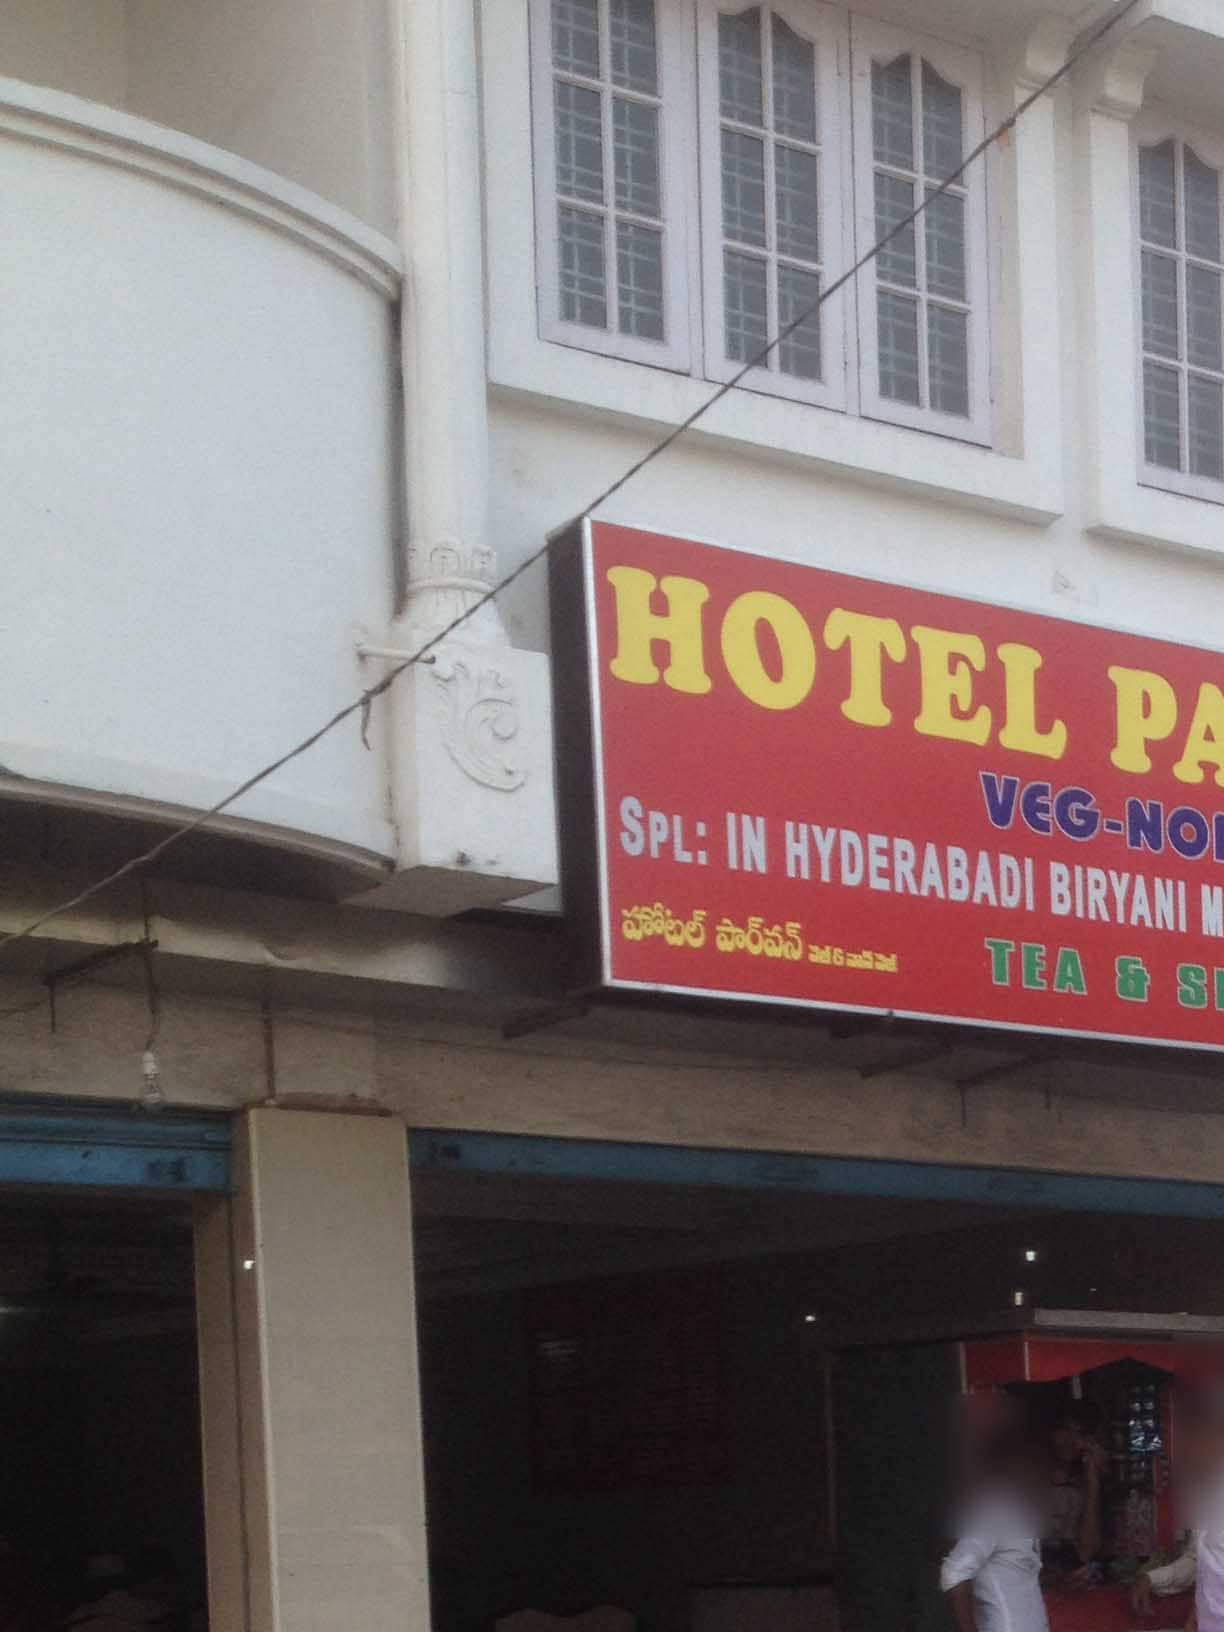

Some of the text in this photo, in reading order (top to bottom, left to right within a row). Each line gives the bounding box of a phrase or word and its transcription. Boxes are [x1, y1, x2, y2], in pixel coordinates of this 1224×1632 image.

[607, 566, 1067, 759] HOTEL
[726, 812, 767, 874] IN
[785, 820, 1035, 912] HYDERABADI
[1049, 861, 1187, 934] BIRYANI
[984, 937, 1088, 996] TEA
[1114, 955, 1150, 1003] &
